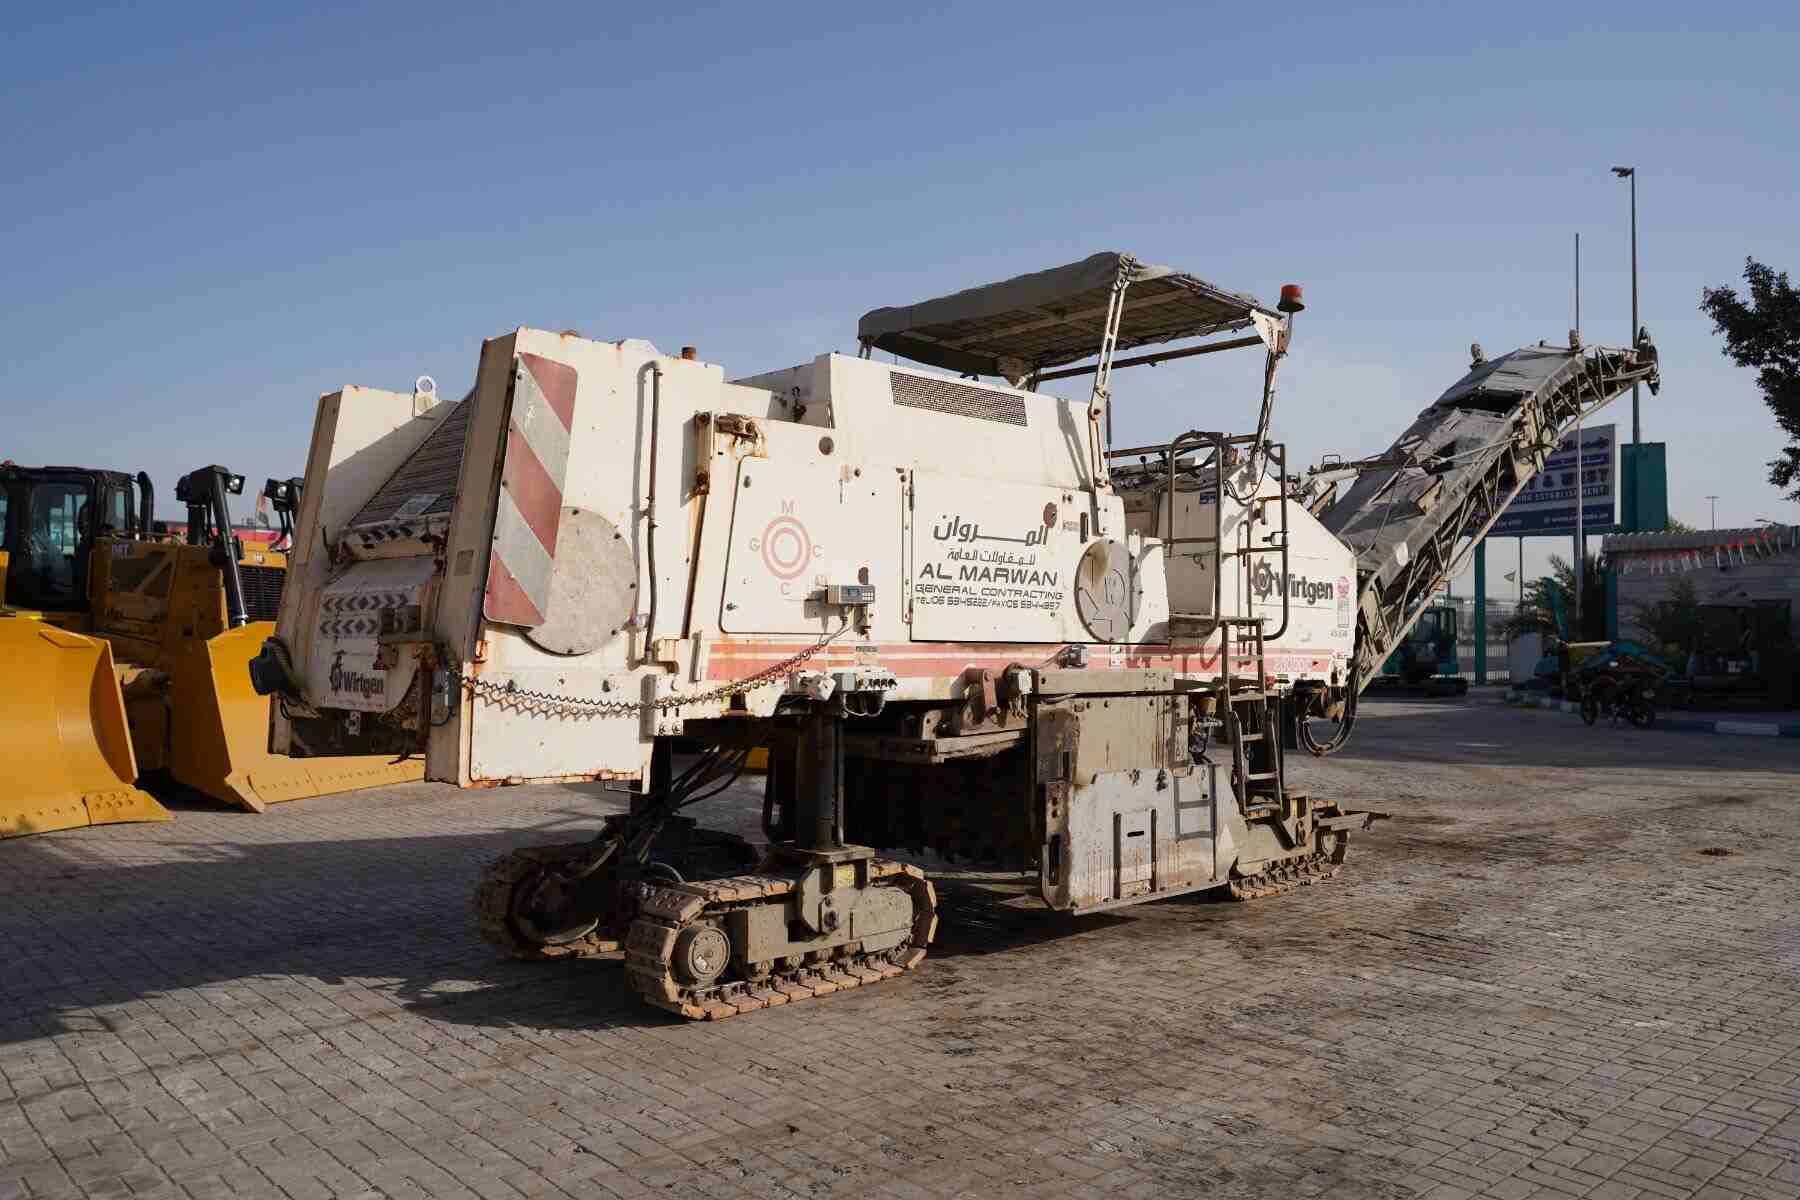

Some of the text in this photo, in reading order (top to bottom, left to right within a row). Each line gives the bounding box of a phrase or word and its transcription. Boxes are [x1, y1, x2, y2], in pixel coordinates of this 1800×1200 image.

[782, 501, 795, 513] M
[933, 515, 1049, 546] المروان
[920, 563, 1058, 586] AL MARWAN
[915, 584, 1063, 600] GENERAL CONTRACTING
[1274, 572, 1334, 605] Wirtgen
[343, 671, 384, 699] Wirtgen
